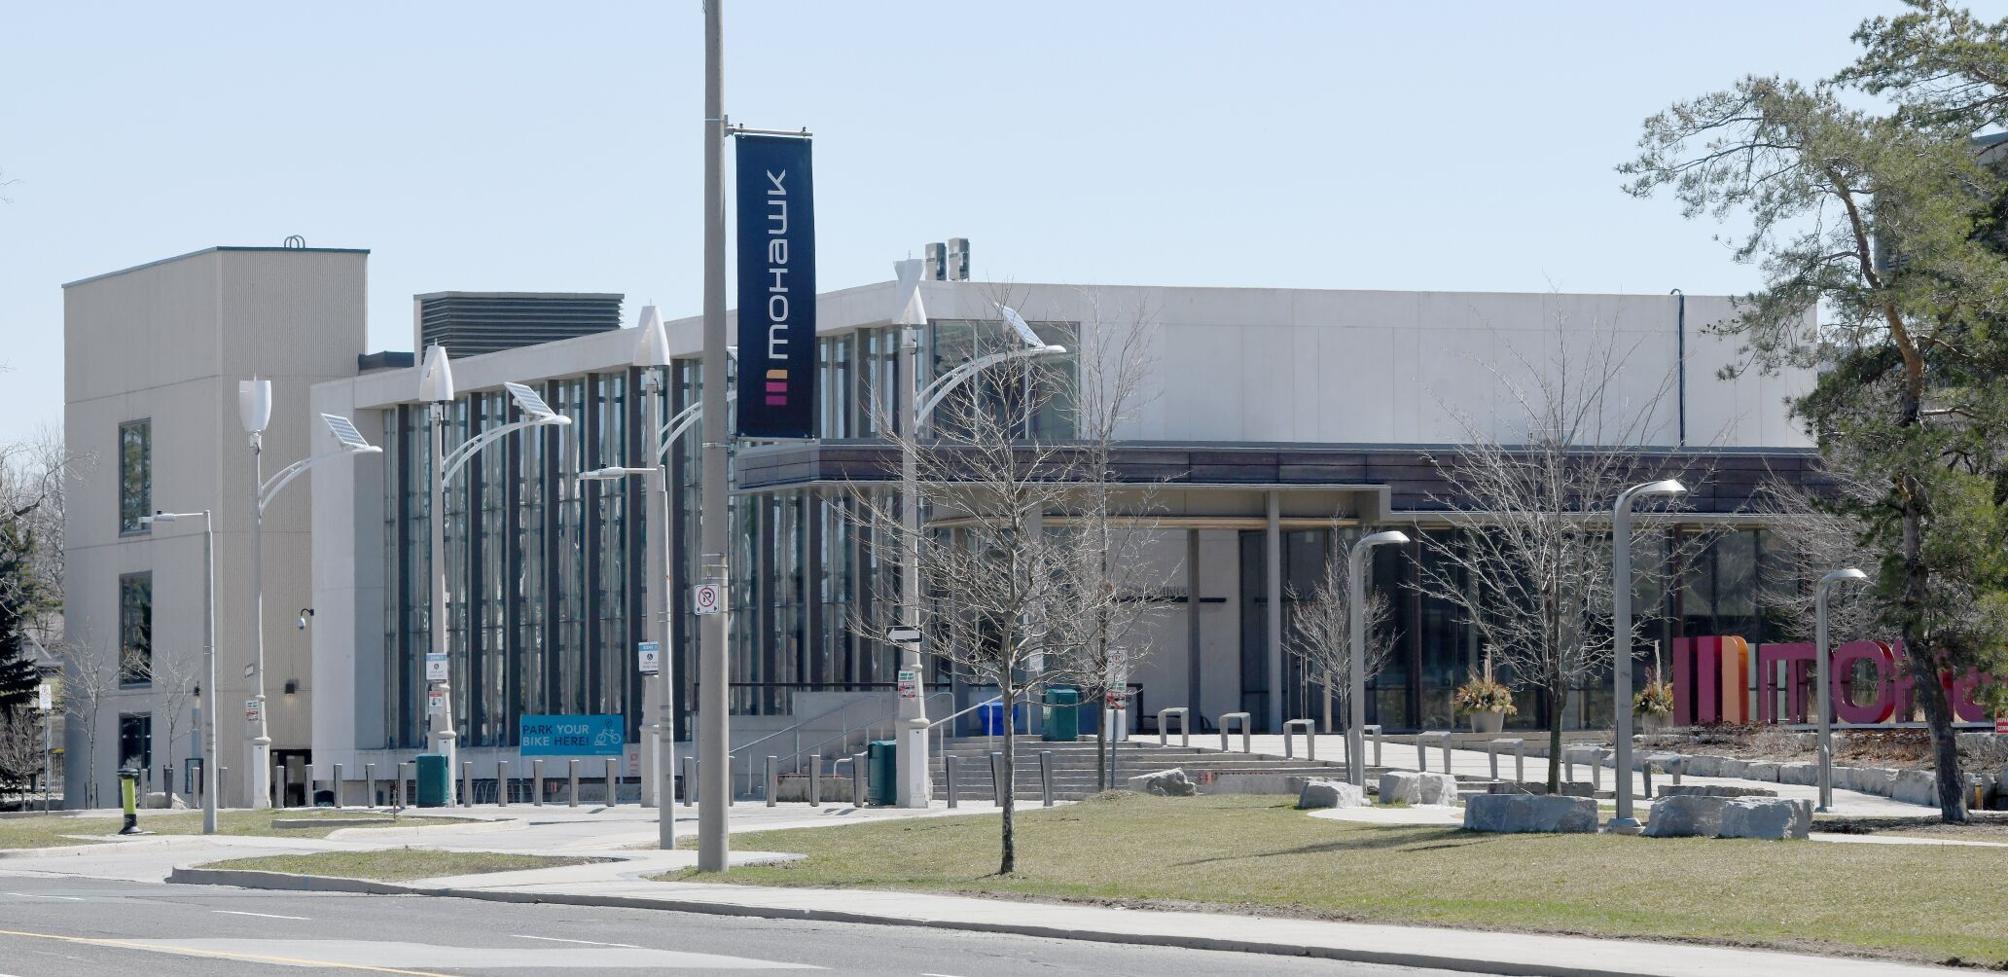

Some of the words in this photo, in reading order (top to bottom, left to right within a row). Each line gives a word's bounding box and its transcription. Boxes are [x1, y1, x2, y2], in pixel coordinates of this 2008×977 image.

[522, 725, 553, 735] PARK
[556, 724, 589, 734] YOUR
[522, 736, 550, 746] BIKE
[554, 736, 589, 746] HERE!
